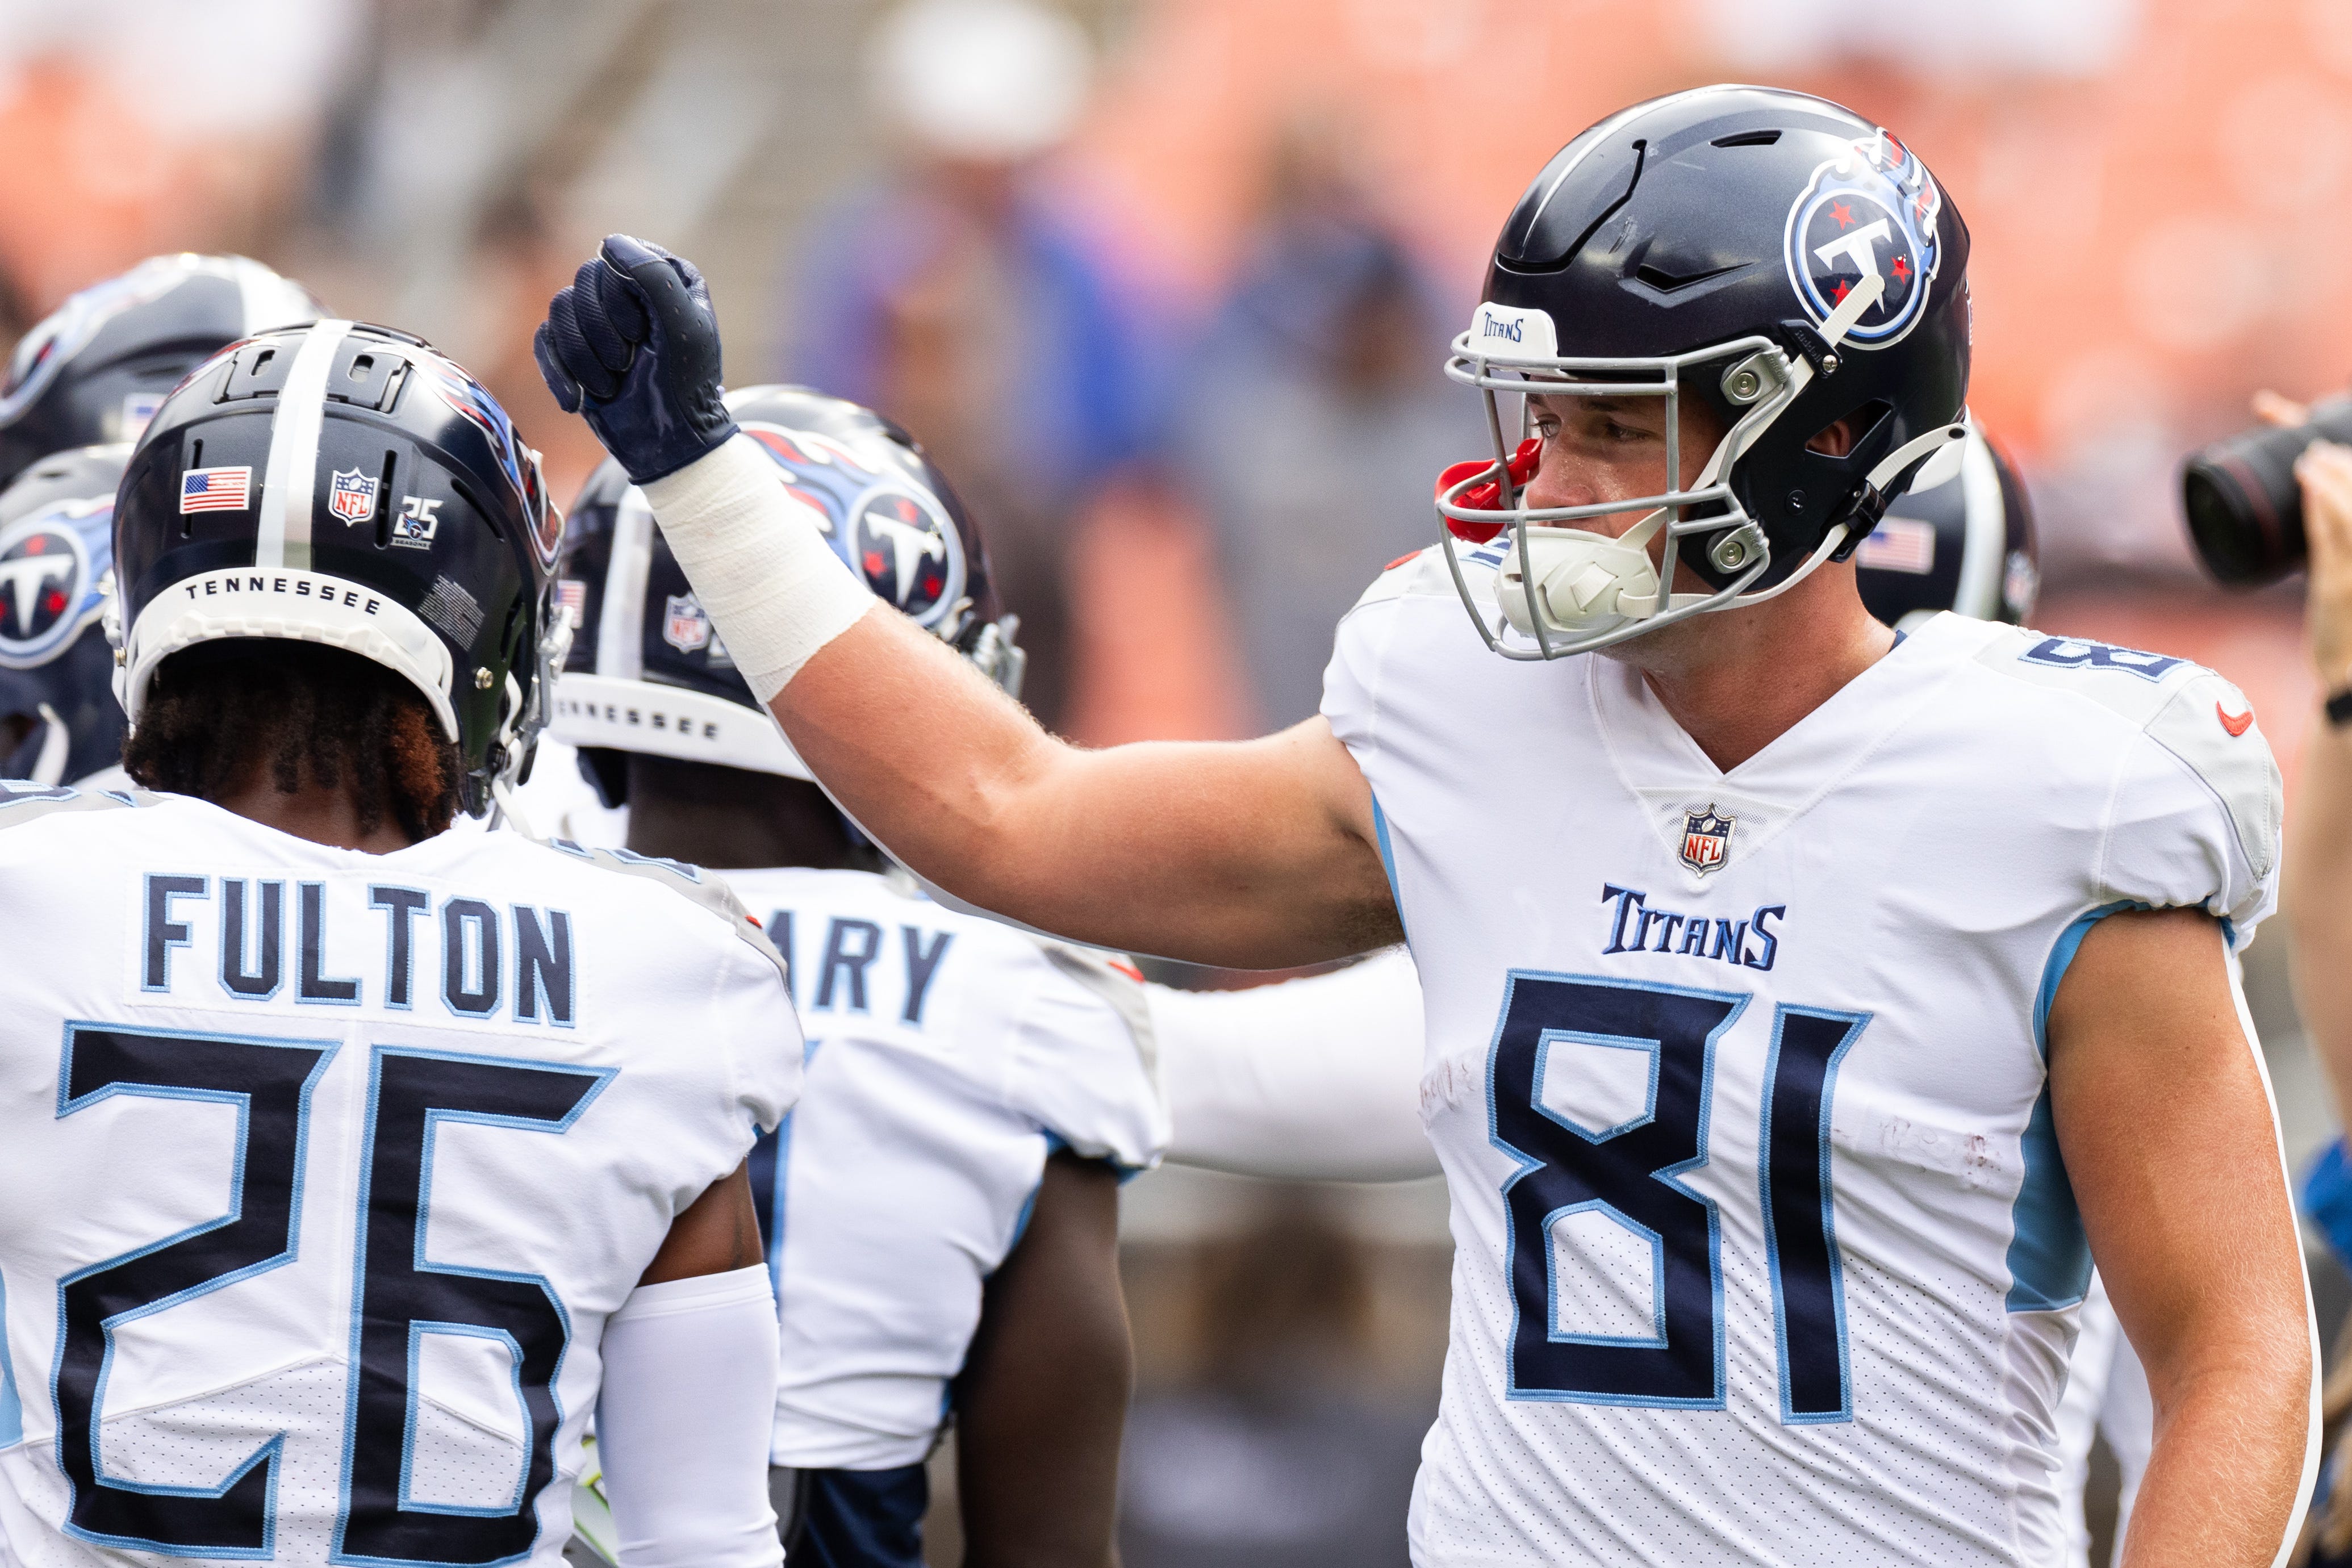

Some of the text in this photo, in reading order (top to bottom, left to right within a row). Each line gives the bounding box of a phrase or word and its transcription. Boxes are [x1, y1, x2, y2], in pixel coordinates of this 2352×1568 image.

[335, 492, 367, 516] NFL
[393, 495, 444, 540] 25
[863, 511, 946, 608] T
[186, 577, 380, 615] TENNESSEE
[1685, 834, 1720, 863] NFL
[141, 872, 576, 1028] FULTON
[1485, 968, 1873, 1426] 81
[49, 1018, 621, 1568] 26
